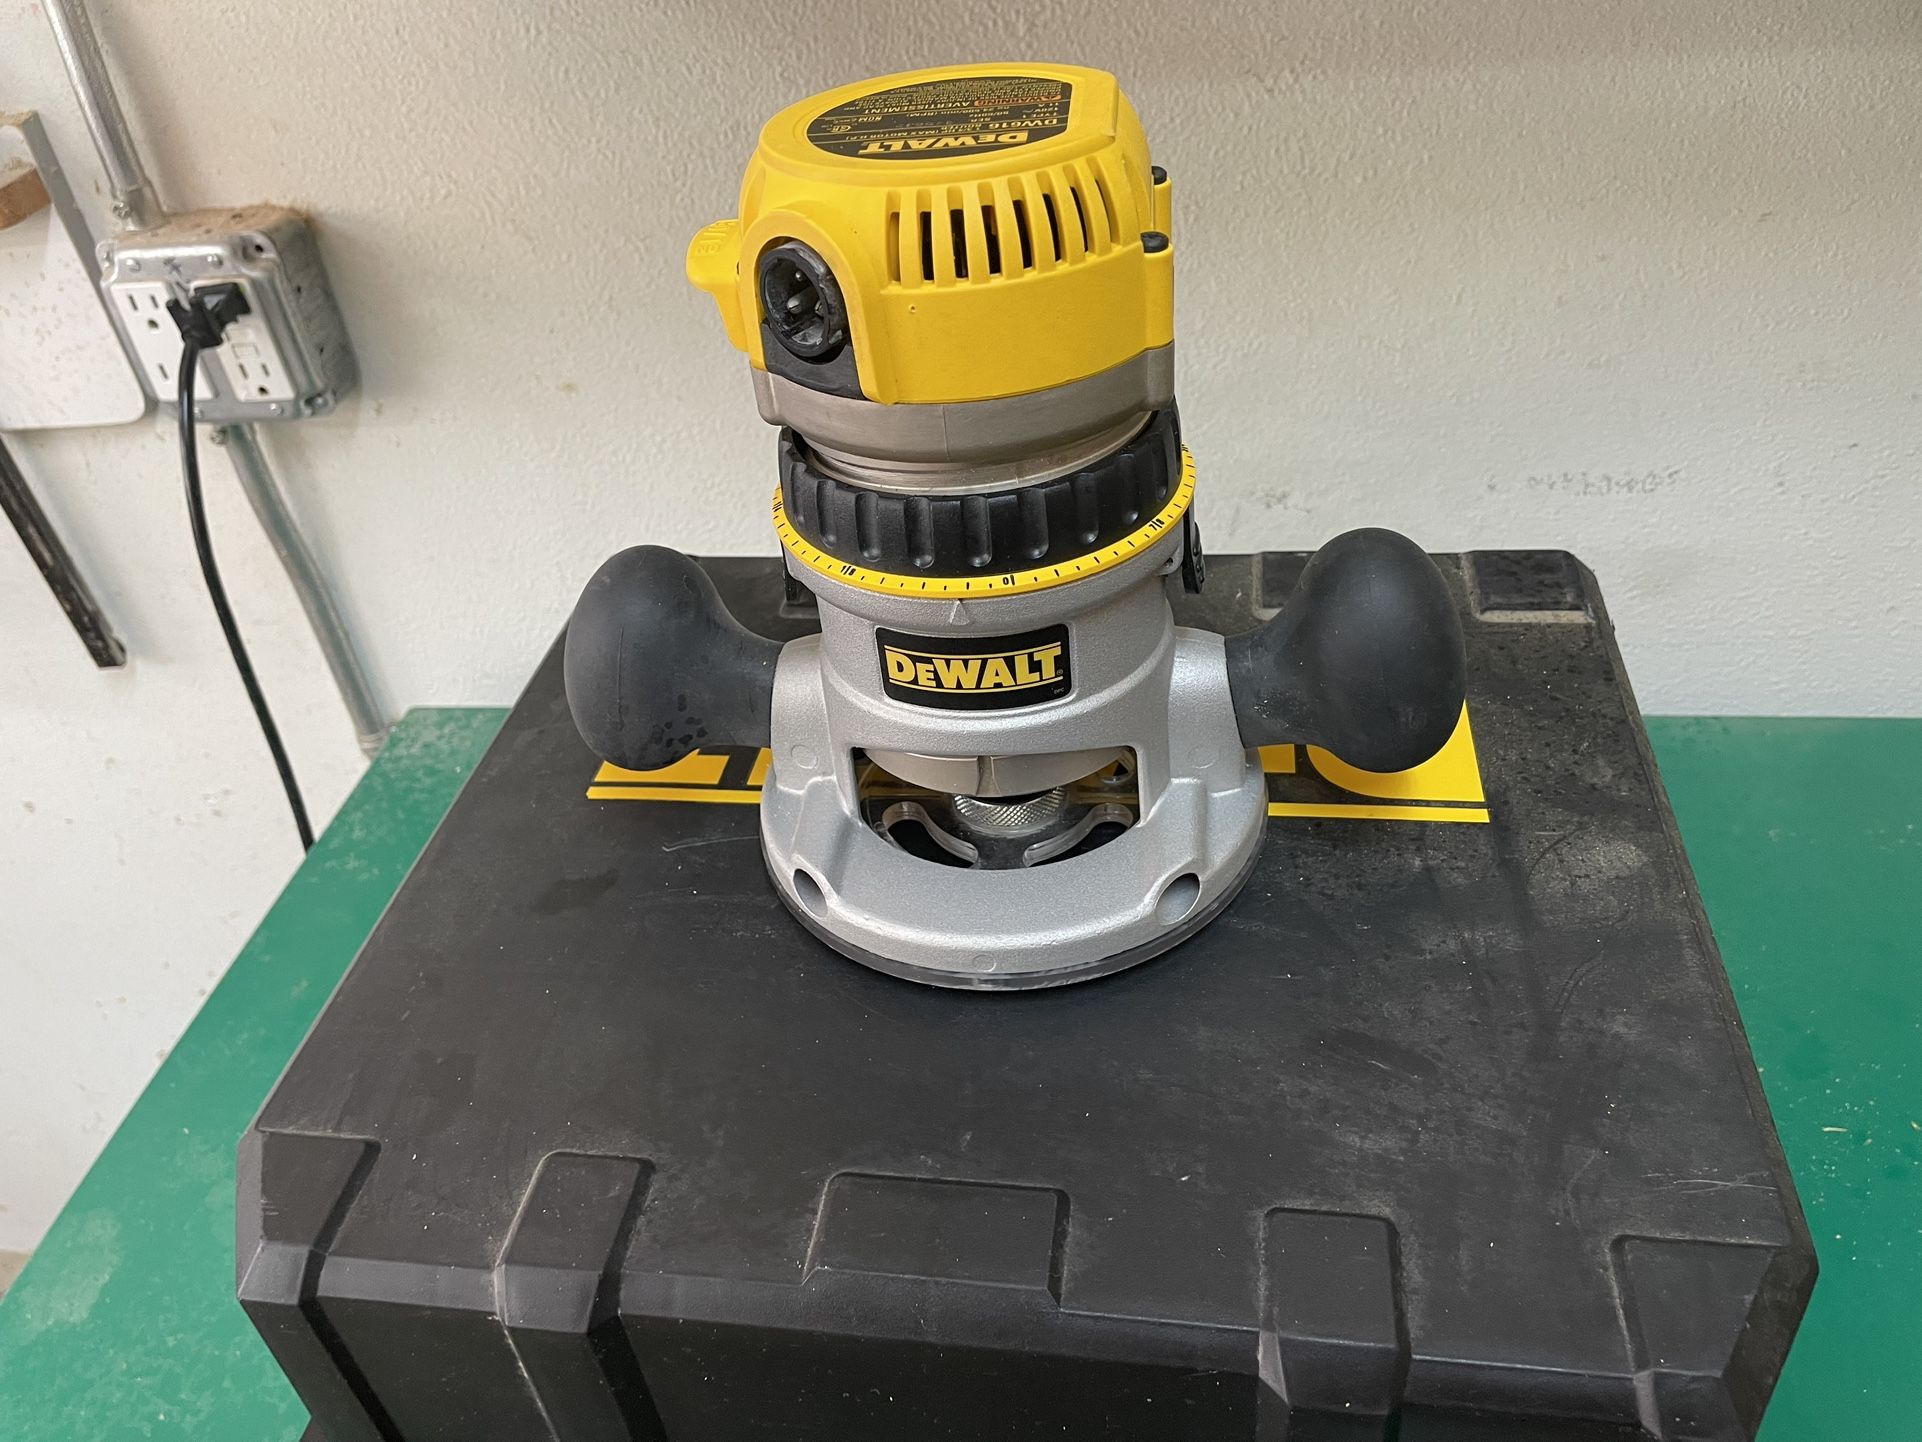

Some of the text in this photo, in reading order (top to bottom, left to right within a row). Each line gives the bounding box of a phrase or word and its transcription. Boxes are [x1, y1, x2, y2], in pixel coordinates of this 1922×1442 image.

[977, 97, 1040, 105] WARNING
[864, 101, 970, 114] AVERTISSEMENT
[989, 118, 1057, 129] DW616
